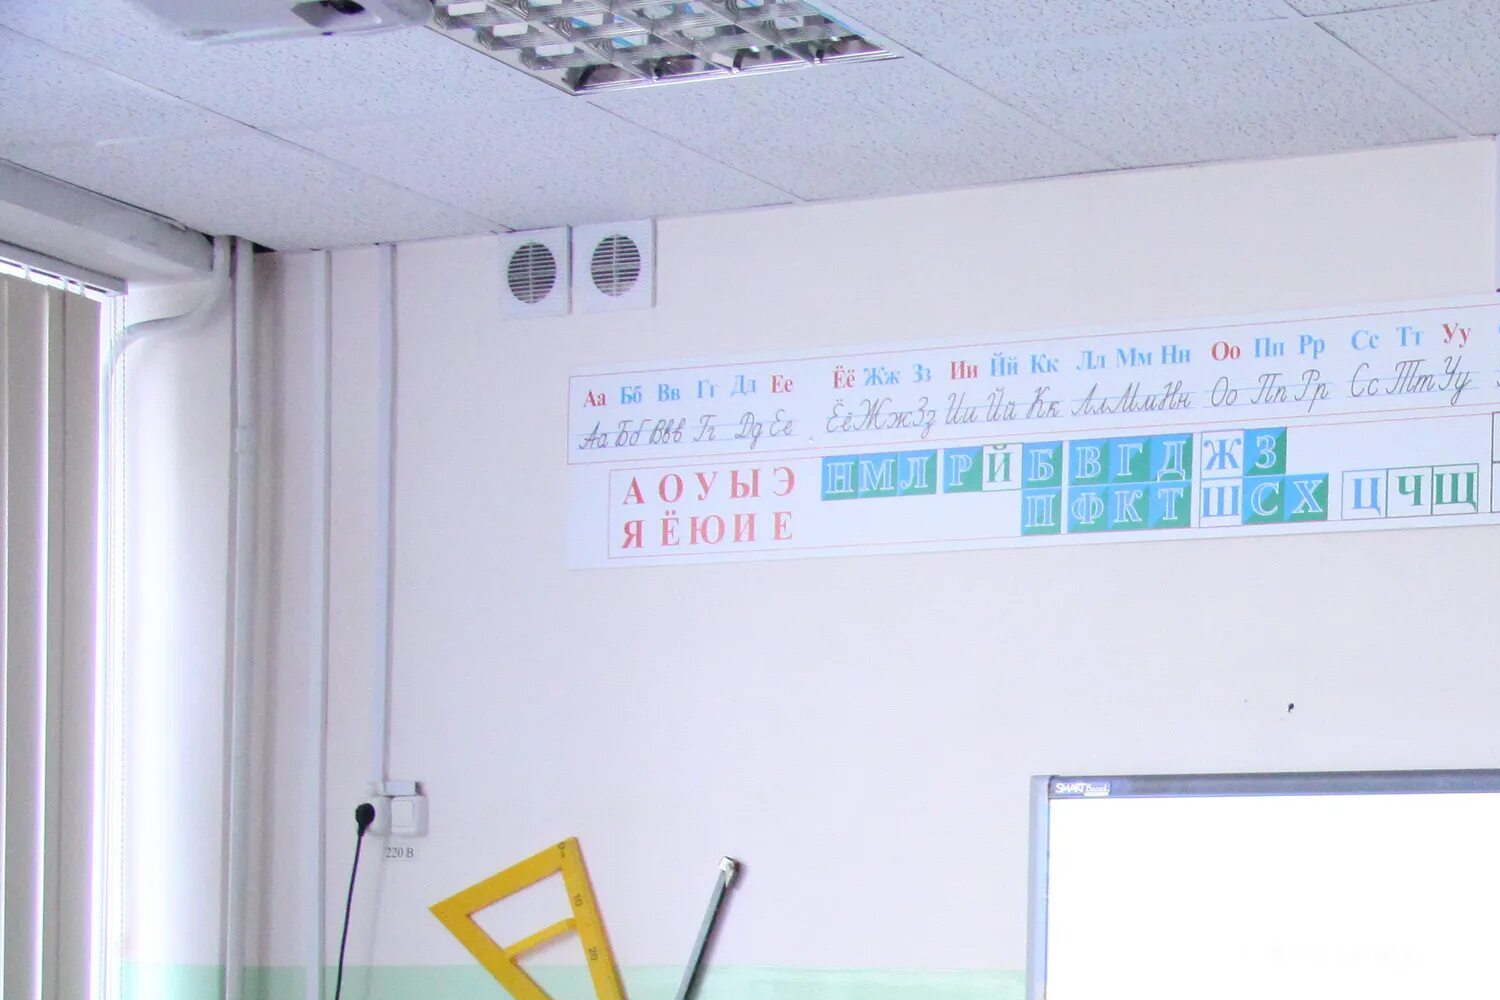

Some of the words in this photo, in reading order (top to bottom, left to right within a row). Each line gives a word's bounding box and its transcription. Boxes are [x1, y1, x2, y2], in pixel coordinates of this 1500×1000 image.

[584, 389, 607, 408] Аа
[620, 385, 643, 404] Бб
[658, 384, 680, 402] Вв
[697, 380, 717, 398] Гг
[730, 375, 756, 396] Дд
[771, 375, 793, 393] Ее
[833, 365, 856, 389] Ёё
[863, 366, 900, 386] Жж
[913, 364, 931, 383] Зз
[950, 361, 979, 381] Ии
[990, 353, 1018, 377] Йй
[1030, 353, 1059, 374] Кк
[1076, 351, 1106, 370] Лл
[1116, 347, 1152, 368] Мм
[1161, 345, 1191, 365] Нн
[1211, 341, 1241, 361] Оо
[1254, 337, 1285, 358] Пп
[1299, 334, 1325, 359] Рр
[1351, 330, 1380, 350] Сс
[1396, 326, 1424, 347] Тт
[1442, 323, 1471, 348] Уу
[826, 462, 854, 494] Н
[858, 459, 895, 491] М
[900, 457, 928, 489] Л
[949, 455, 972, 486] Р
[986, 444, 1013, 483] Й
[1029, 448, 1054, 481] Б
[1075, 446, 1101, 478] В
[1117, 443, 1143, 476] Г
[1157, 441, 1186, 481] Д
[1203, 438, 1242, 470] Ж
[1255, 435, 1276, 469] З
[622, 476, 645, 505] А
[658, 473, 684, 503] О
[695, 471, 718, 501] У
[729, 468, 761, 499] Ы
[773, 466, 795, 497] Э
[1024, 495, 1056, 528] П
[1072, 492, 1104, 524] Ф
[1114, 489, 1142, 523] К
[1157, 488, 1184, 520] Т
[1200, 485, 1240, 517] Ш
[1251, 482, 1279, 515] С
[1292, 480, 1322, 514] Х
[1352, 477, 1381, 516] Ц
[1398, 475, 1423, 506] Ч
[1435, 472, 1476, 511] Щ
[621, 520, 644, 548] Я
[661, 510, 679, 546] Ё
[689, 514, 726, 545] Ю
[733, 513, 757, 542] И
[773, 512, 793, 540] Е
[1056, 782, 1086, 793] SMART
[385, 846, 404, 858] 220
